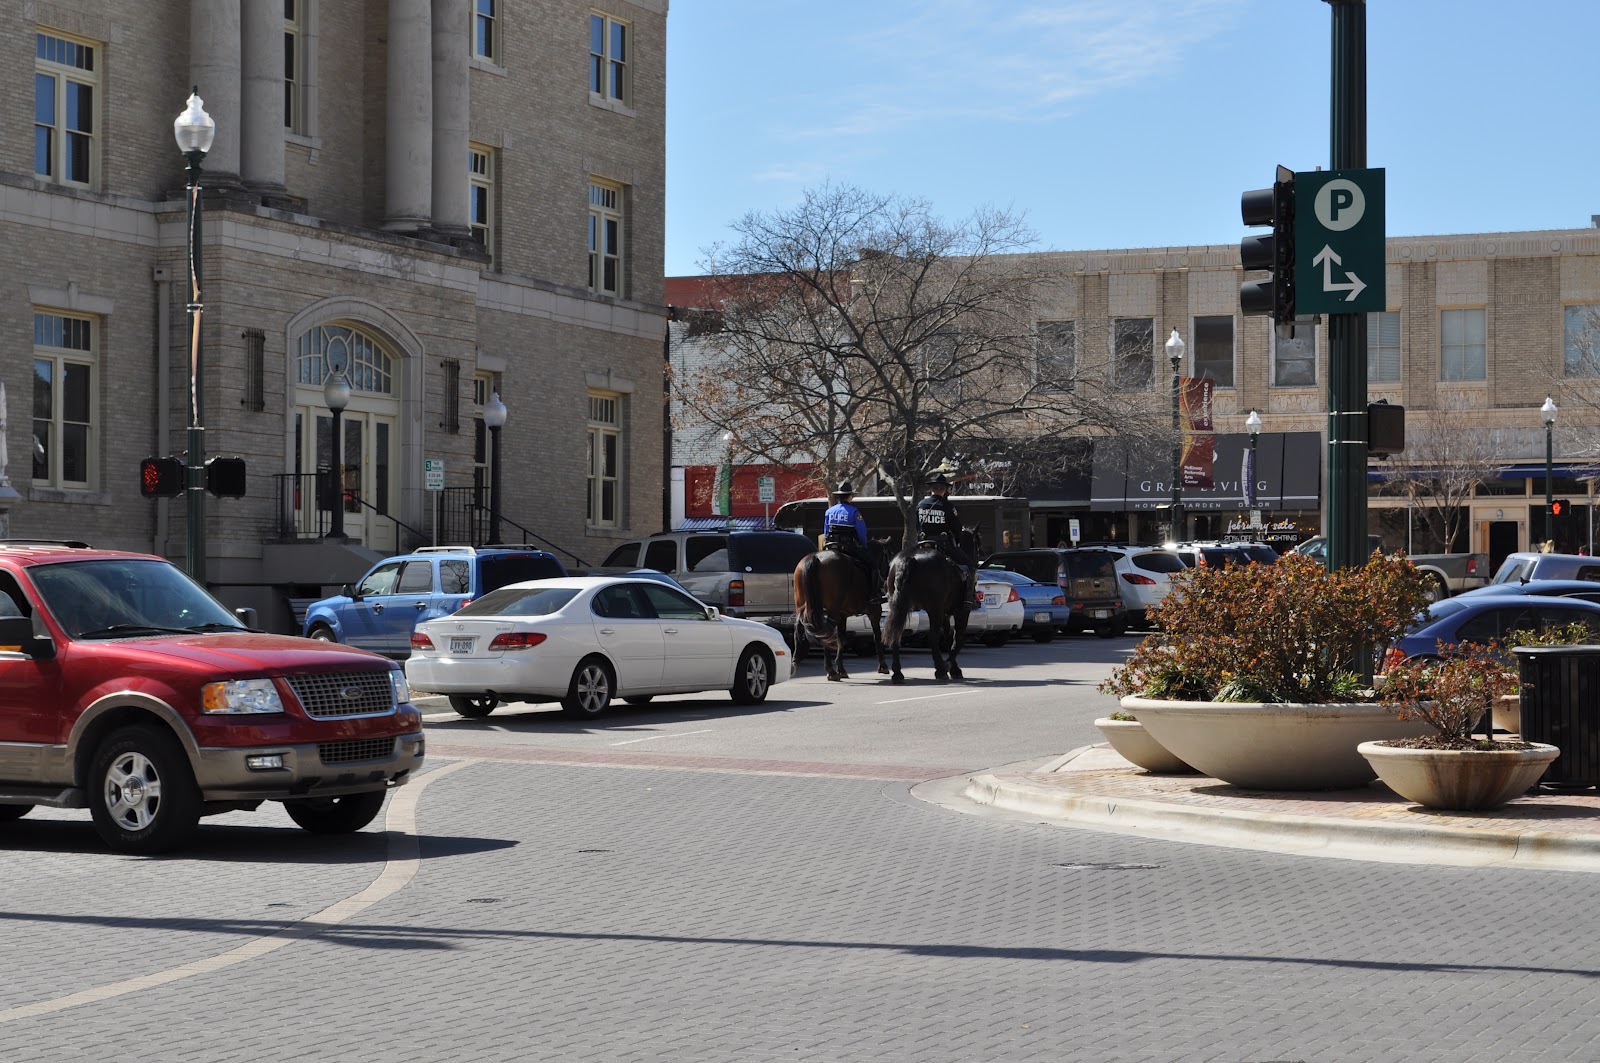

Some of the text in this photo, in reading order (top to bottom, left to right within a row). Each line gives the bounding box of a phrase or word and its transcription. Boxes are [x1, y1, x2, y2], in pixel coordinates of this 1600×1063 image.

[1331, 189, 1353, 221] P
[426, 462, 431, 471] 3
[1140, 481, 1186, 492] GRA
[918, 515, 946, 524] POLICE
[1227, 519, 1269, 534] februry
